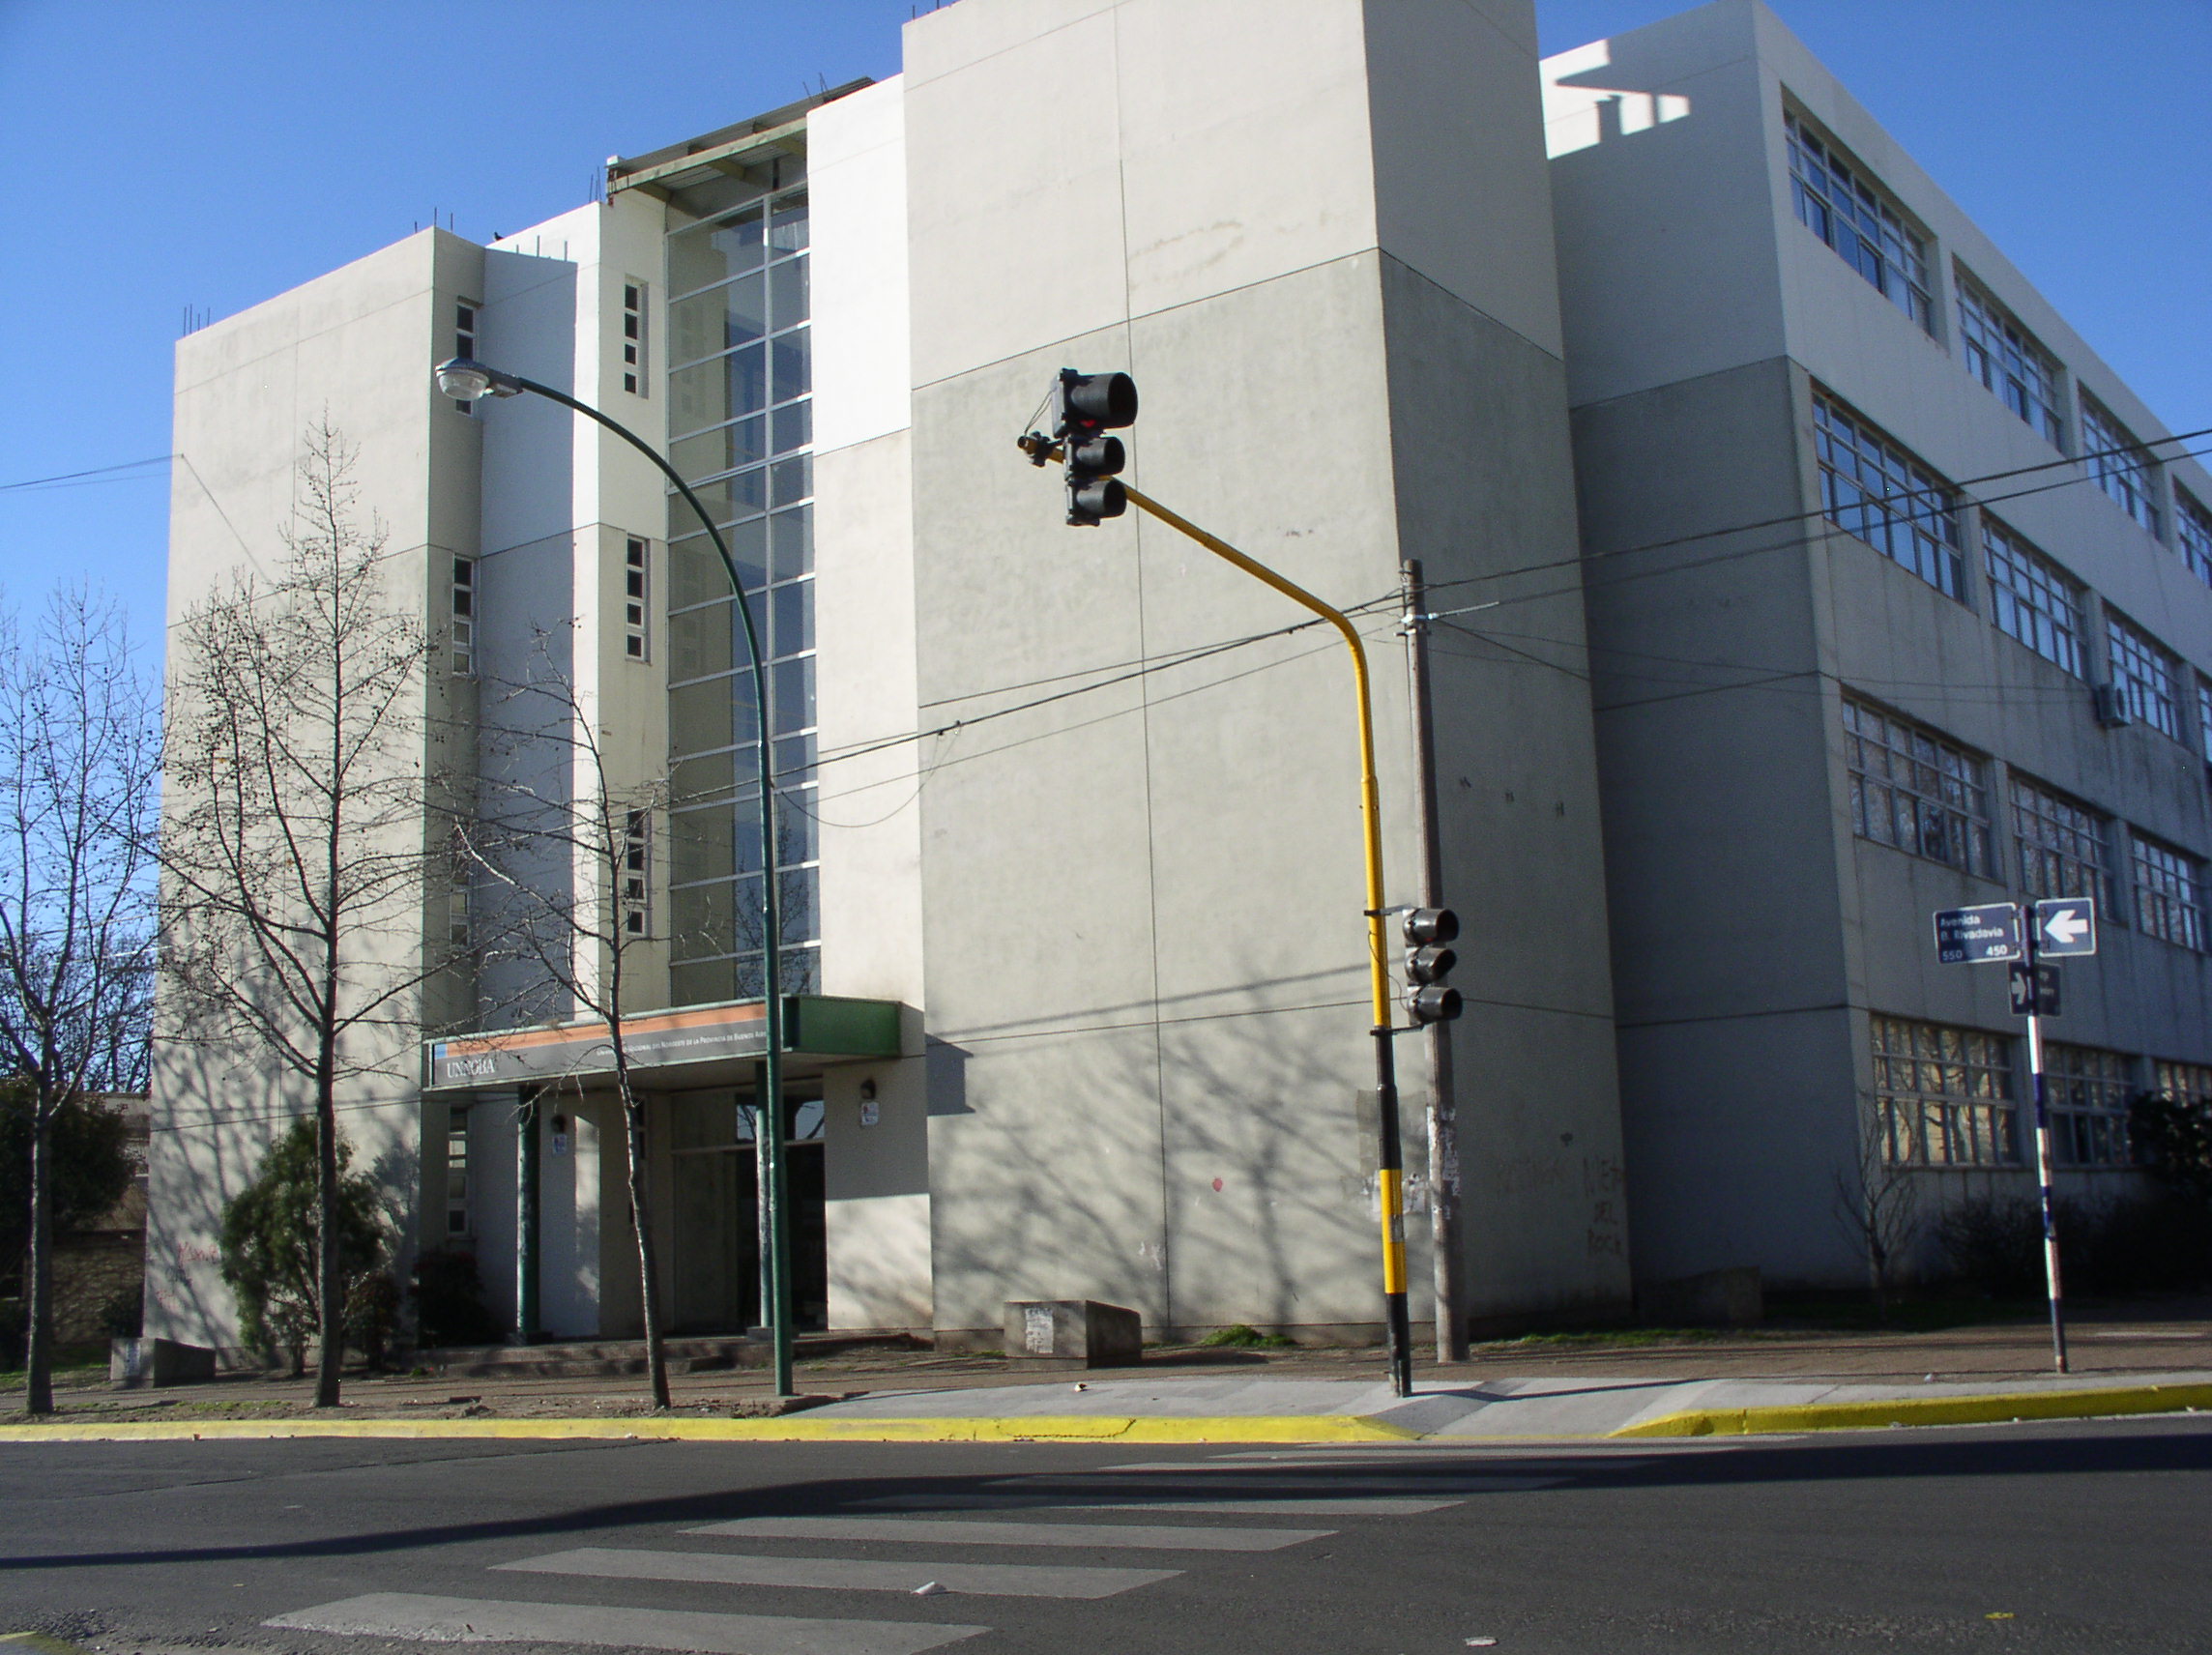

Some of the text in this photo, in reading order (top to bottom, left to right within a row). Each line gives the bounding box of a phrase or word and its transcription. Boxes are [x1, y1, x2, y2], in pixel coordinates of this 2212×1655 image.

[1941, 915, 1981, 927] Avenida
[1954, 926, 2004, 941] Rivadavia
[1942, 944, 2008, 961] 550 450
[447, 1058, 497, 1079] UNNOBA
